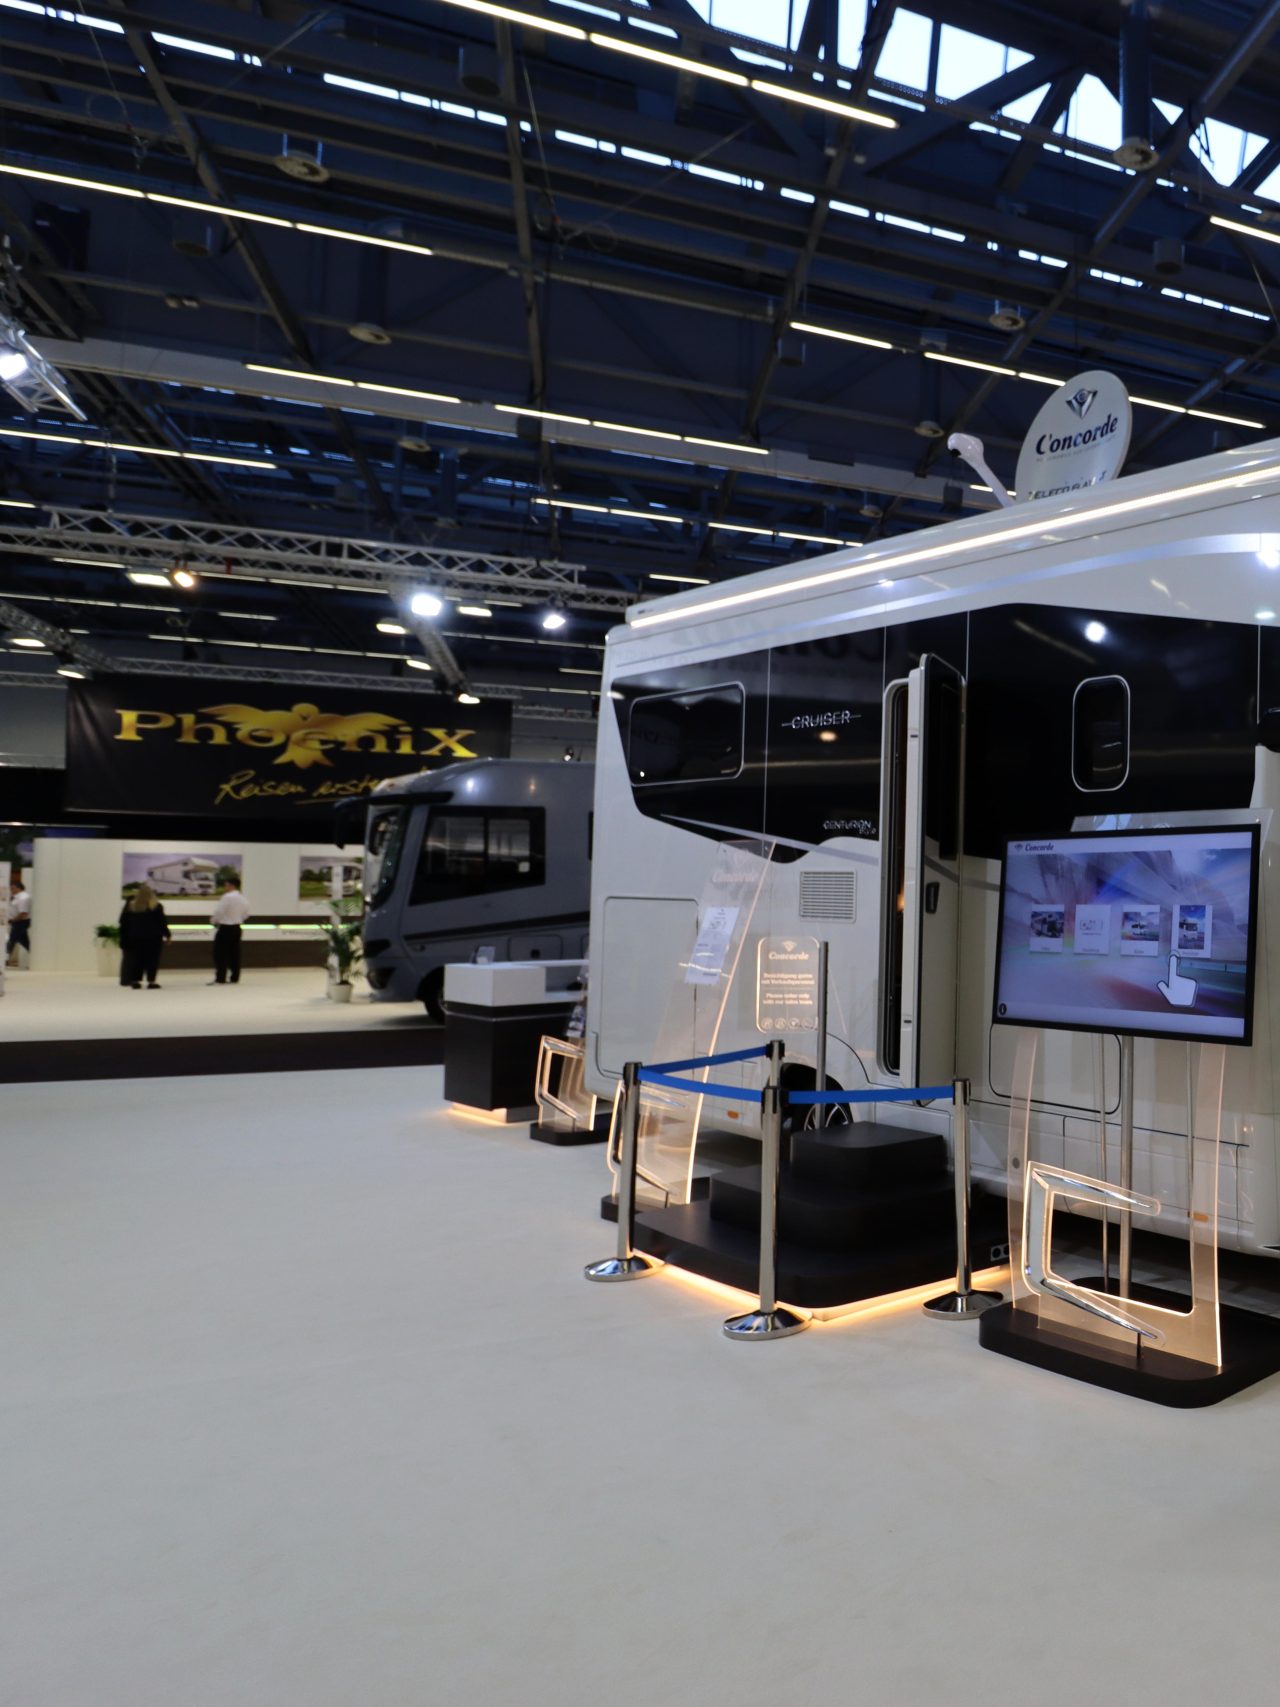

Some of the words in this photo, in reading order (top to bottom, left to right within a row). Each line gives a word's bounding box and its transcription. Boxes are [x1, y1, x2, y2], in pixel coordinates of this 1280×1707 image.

[1036, 413, 1119, 455] Concorde
[791, 709, 851, 729] CRUISER
[215, 770, 306, 805] Reisen
[1025, 842, 1054, 851] Concorde
[769, 951, 809, 960] Concorde
